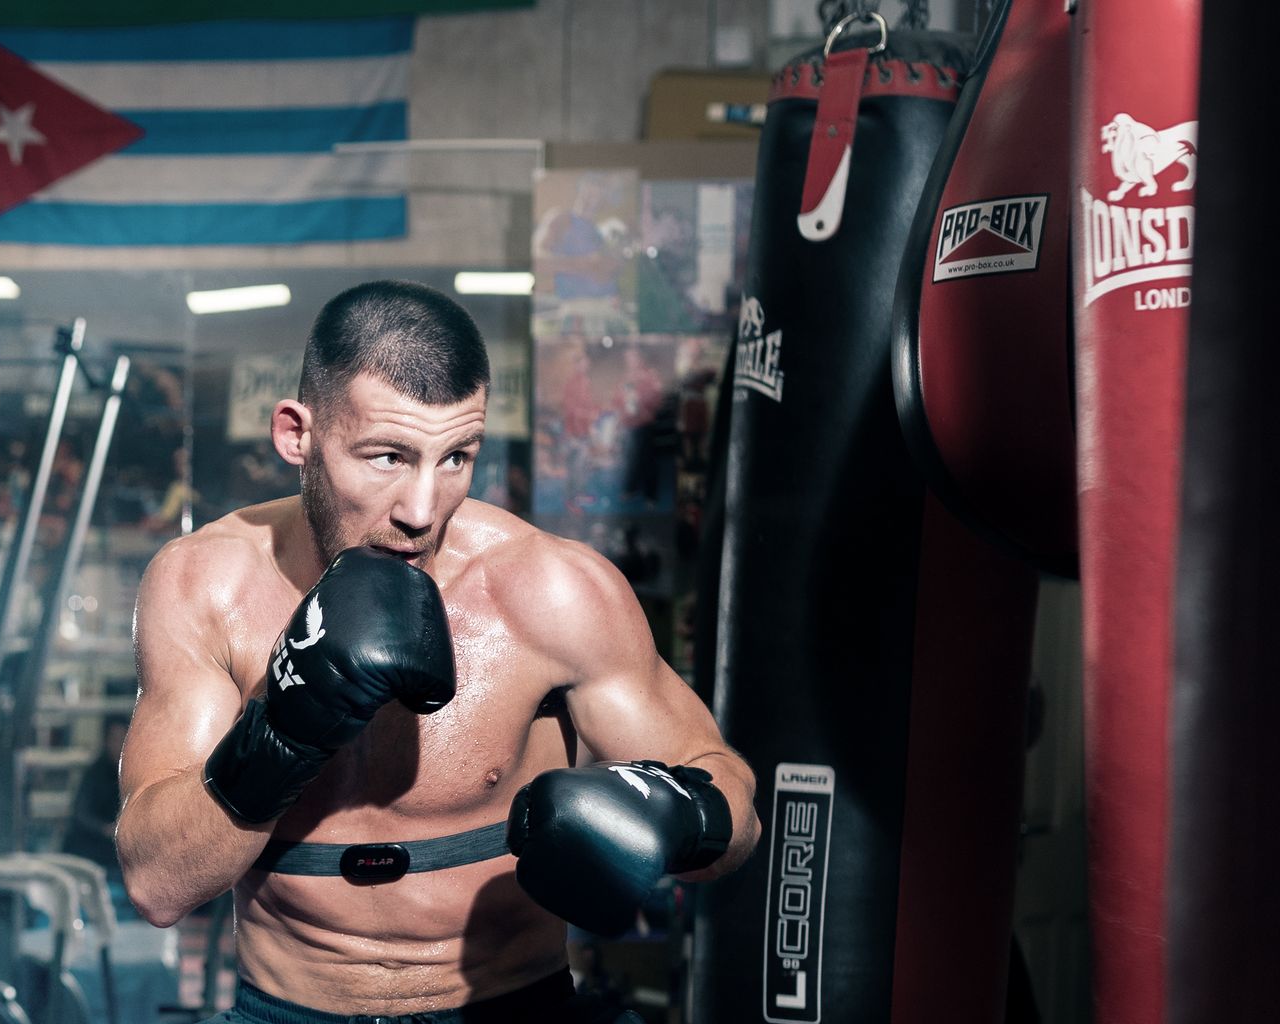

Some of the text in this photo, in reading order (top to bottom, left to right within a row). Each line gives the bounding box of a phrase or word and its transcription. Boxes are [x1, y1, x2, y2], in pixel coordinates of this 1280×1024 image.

[939, 201, 1040, 259] PRO-BOX
[948, 258, 1015, 274] www.pro-box.co.uk
[357, 858, 394, 866] POLAR
